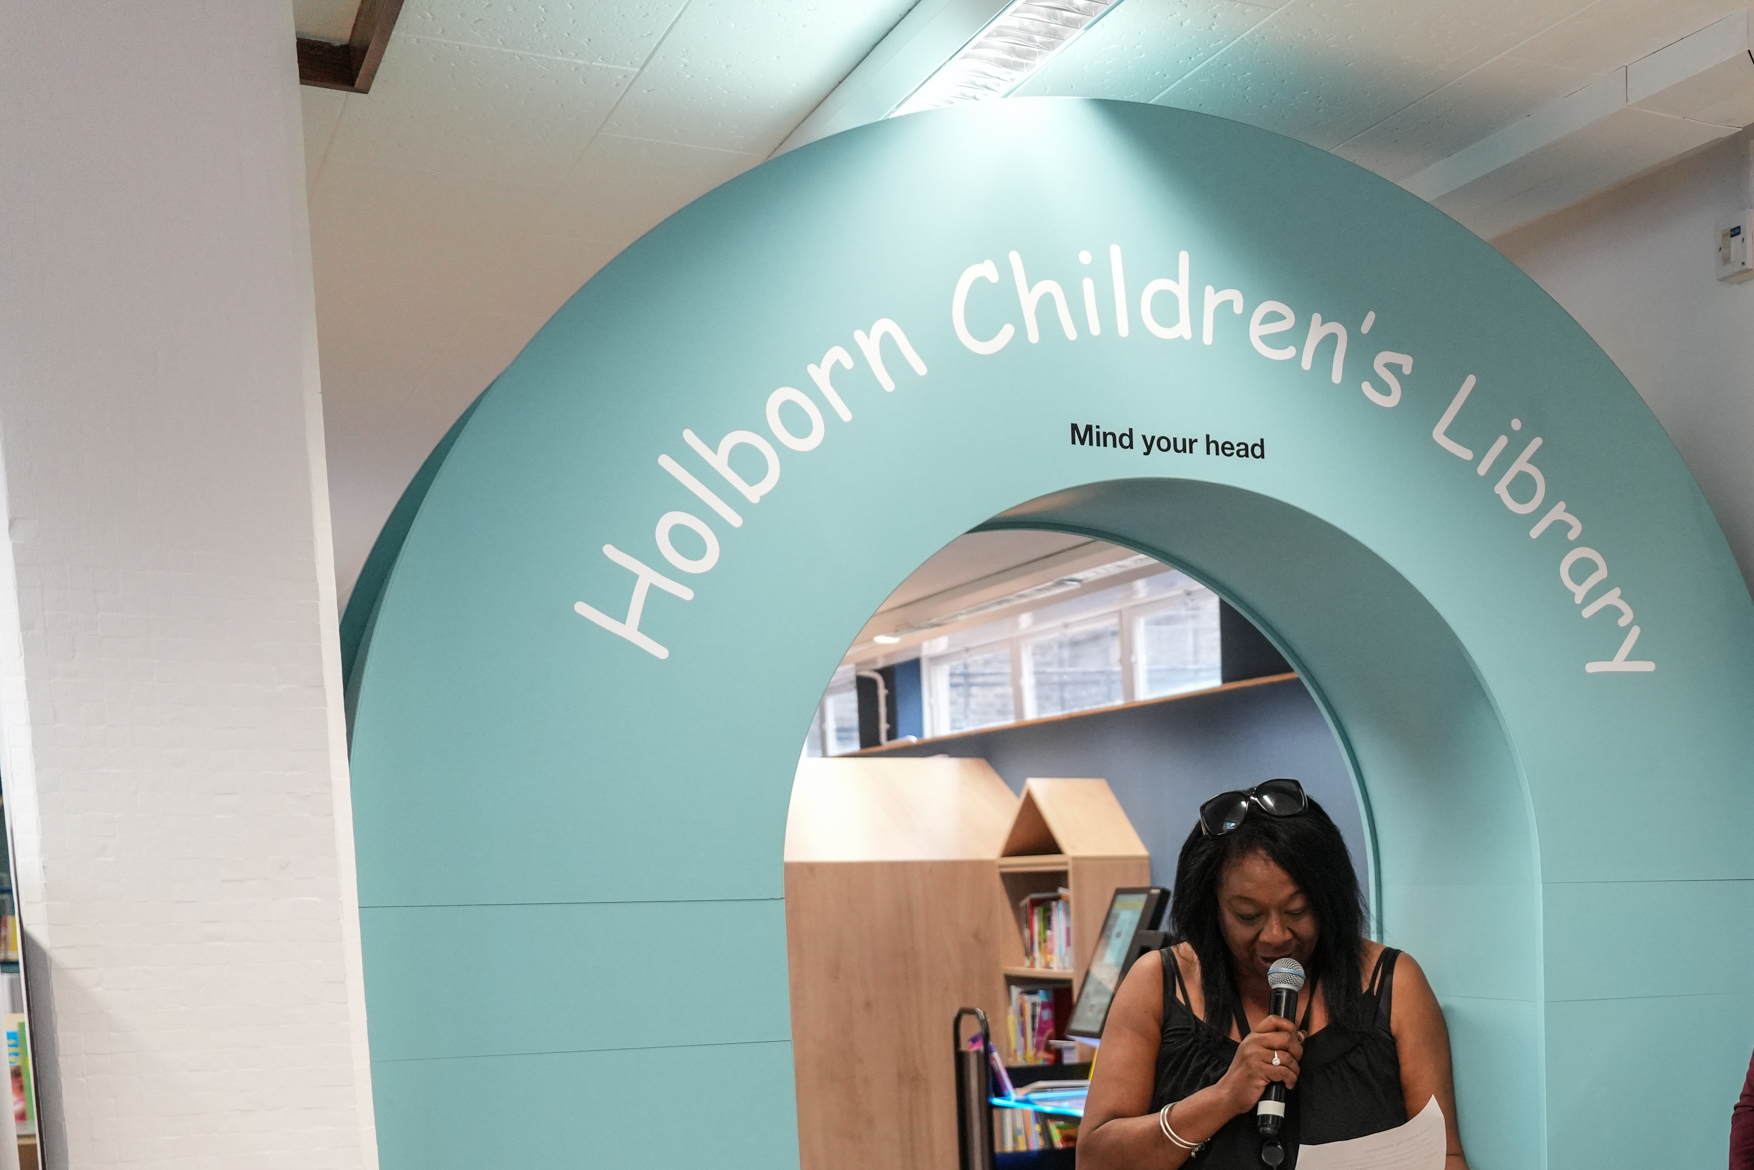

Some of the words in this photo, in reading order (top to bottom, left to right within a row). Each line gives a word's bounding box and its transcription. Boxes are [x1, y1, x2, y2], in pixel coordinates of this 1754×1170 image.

[574, 318, 928, 660] Holborn
[952, 243, 1414, 408] Children's
[1432, 374, 1656, 673] Library
[1070, 422, 1134, 450] Mind
[1141, 434, 1198, 456] your
[1205, 433, 1265, 460] head
